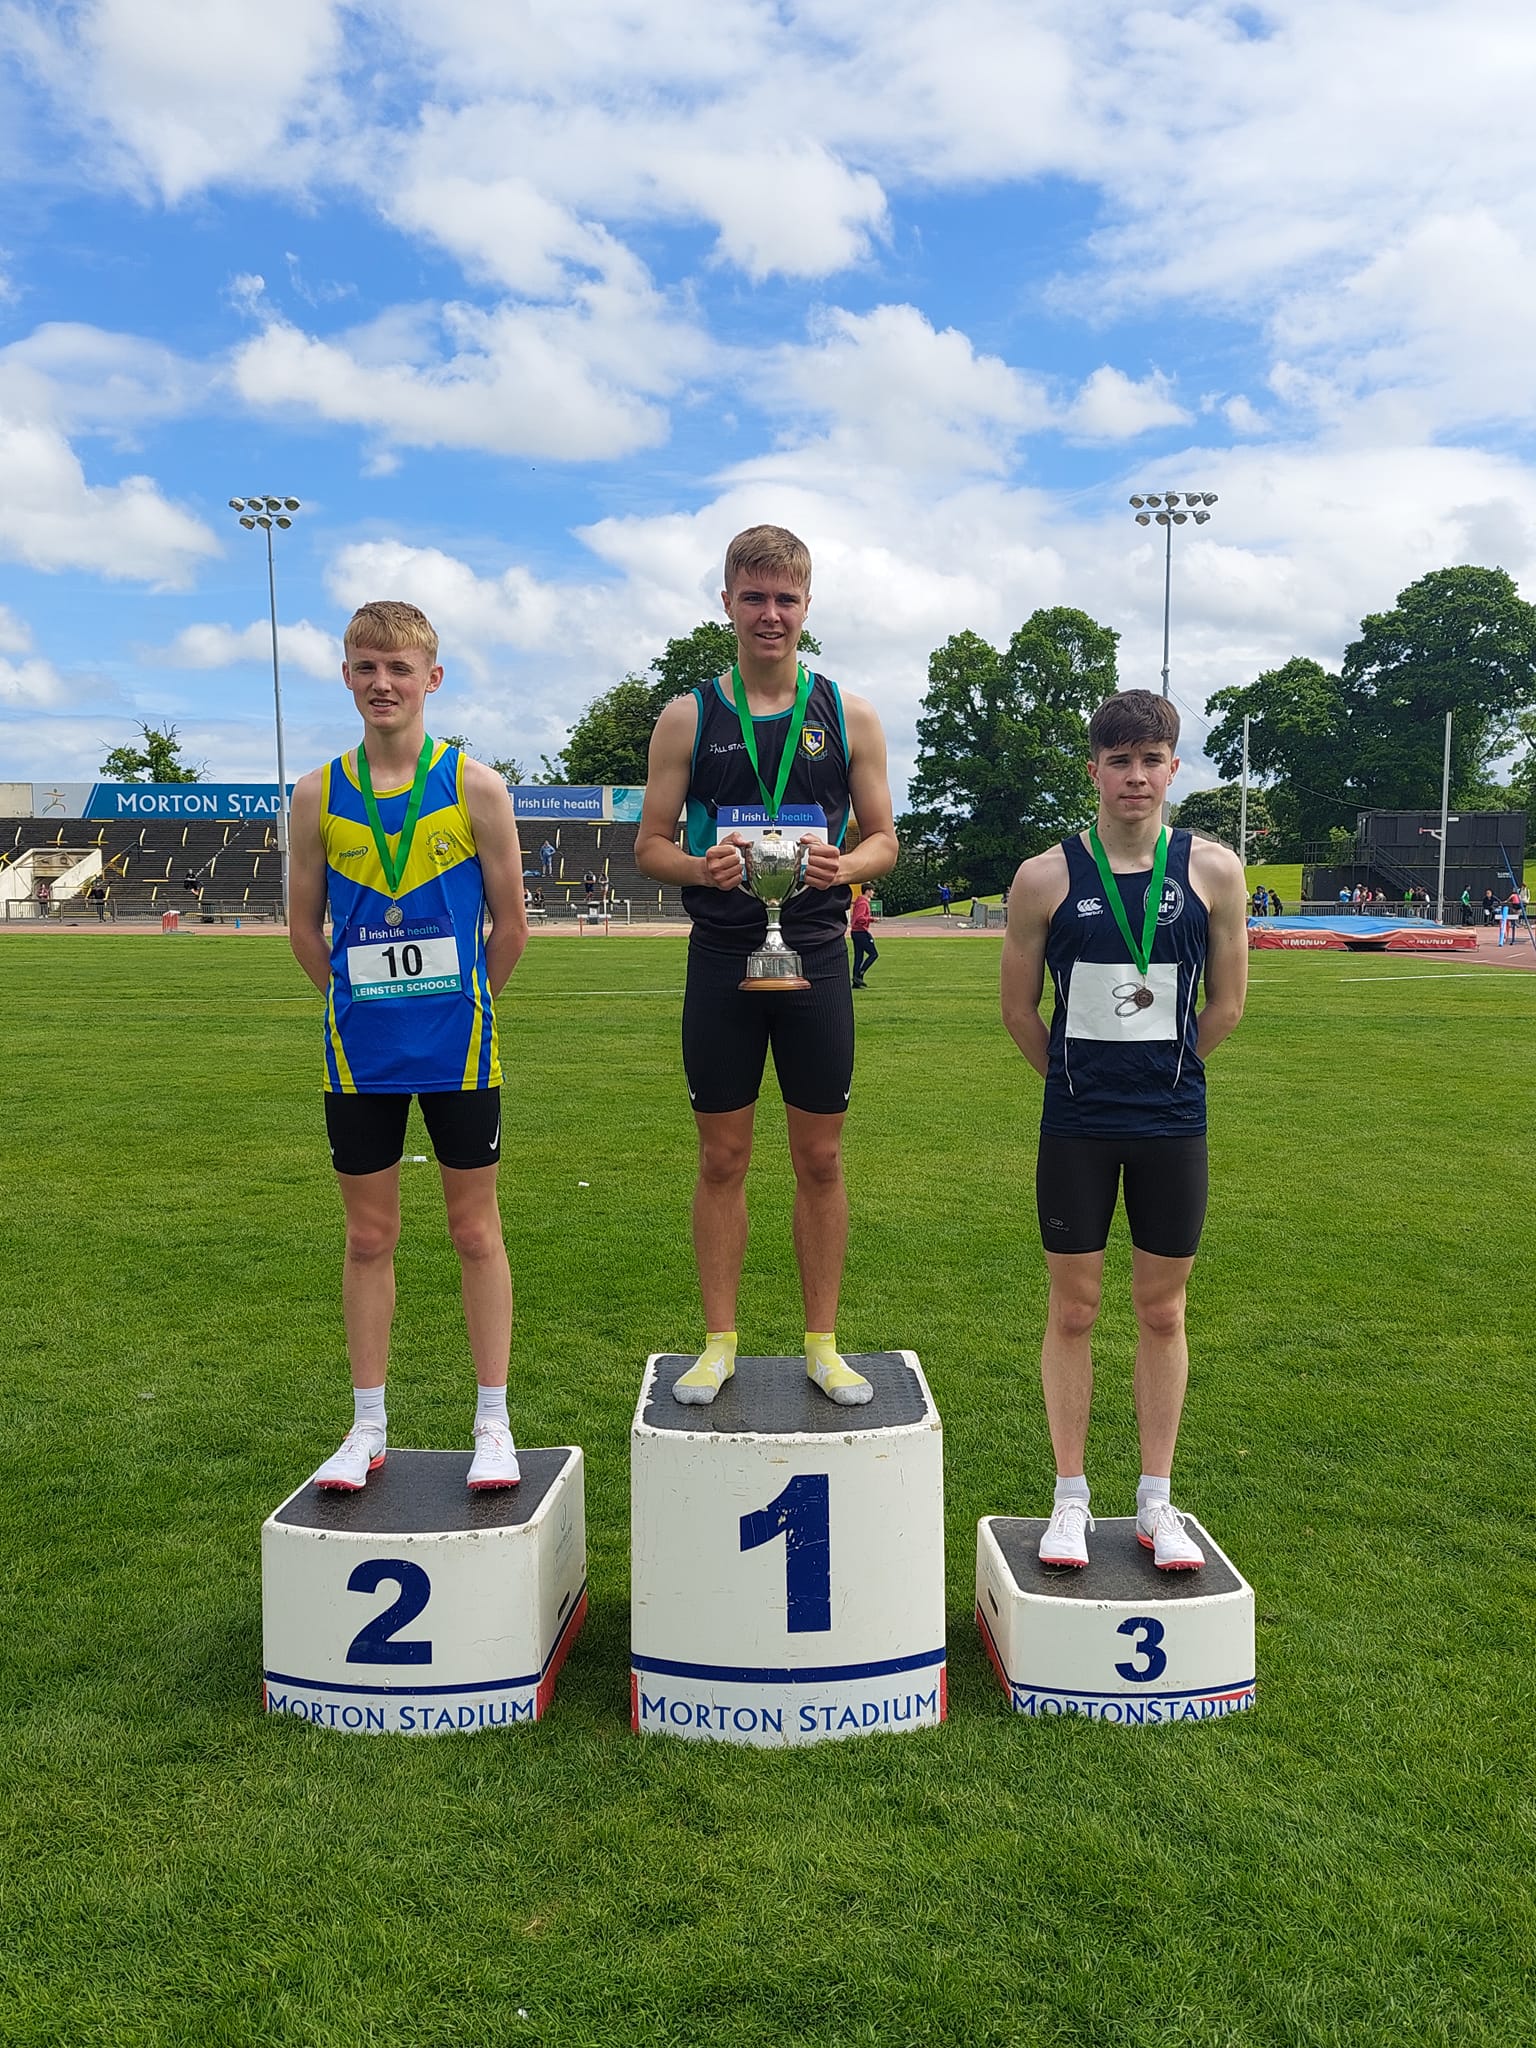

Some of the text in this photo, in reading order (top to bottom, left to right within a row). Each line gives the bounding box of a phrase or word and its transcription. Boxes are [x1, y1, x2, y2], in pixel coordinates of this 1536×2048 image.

[116, 793, 291, 813] MORTON STADI
[518, 797, 600, 809] Irish Life health
[741, 813, 761, 822] Irish
[781, 813, 813, 822] health
[369, 924, 440, 940] Irish Life health
[381, 944, 423, 978] 10
[355, 979, 457, 997] LEINSTER SCHOOLS
[739, 1473, 832, 1634] 1
[346, 1558, 433, 1665] 2
[1114, 1616, 1168, 1682] 3
[267, 1691, 535, 1731] MORTON STADIUM
[639, 1689, 938, 1733] MORTON STADIUM
